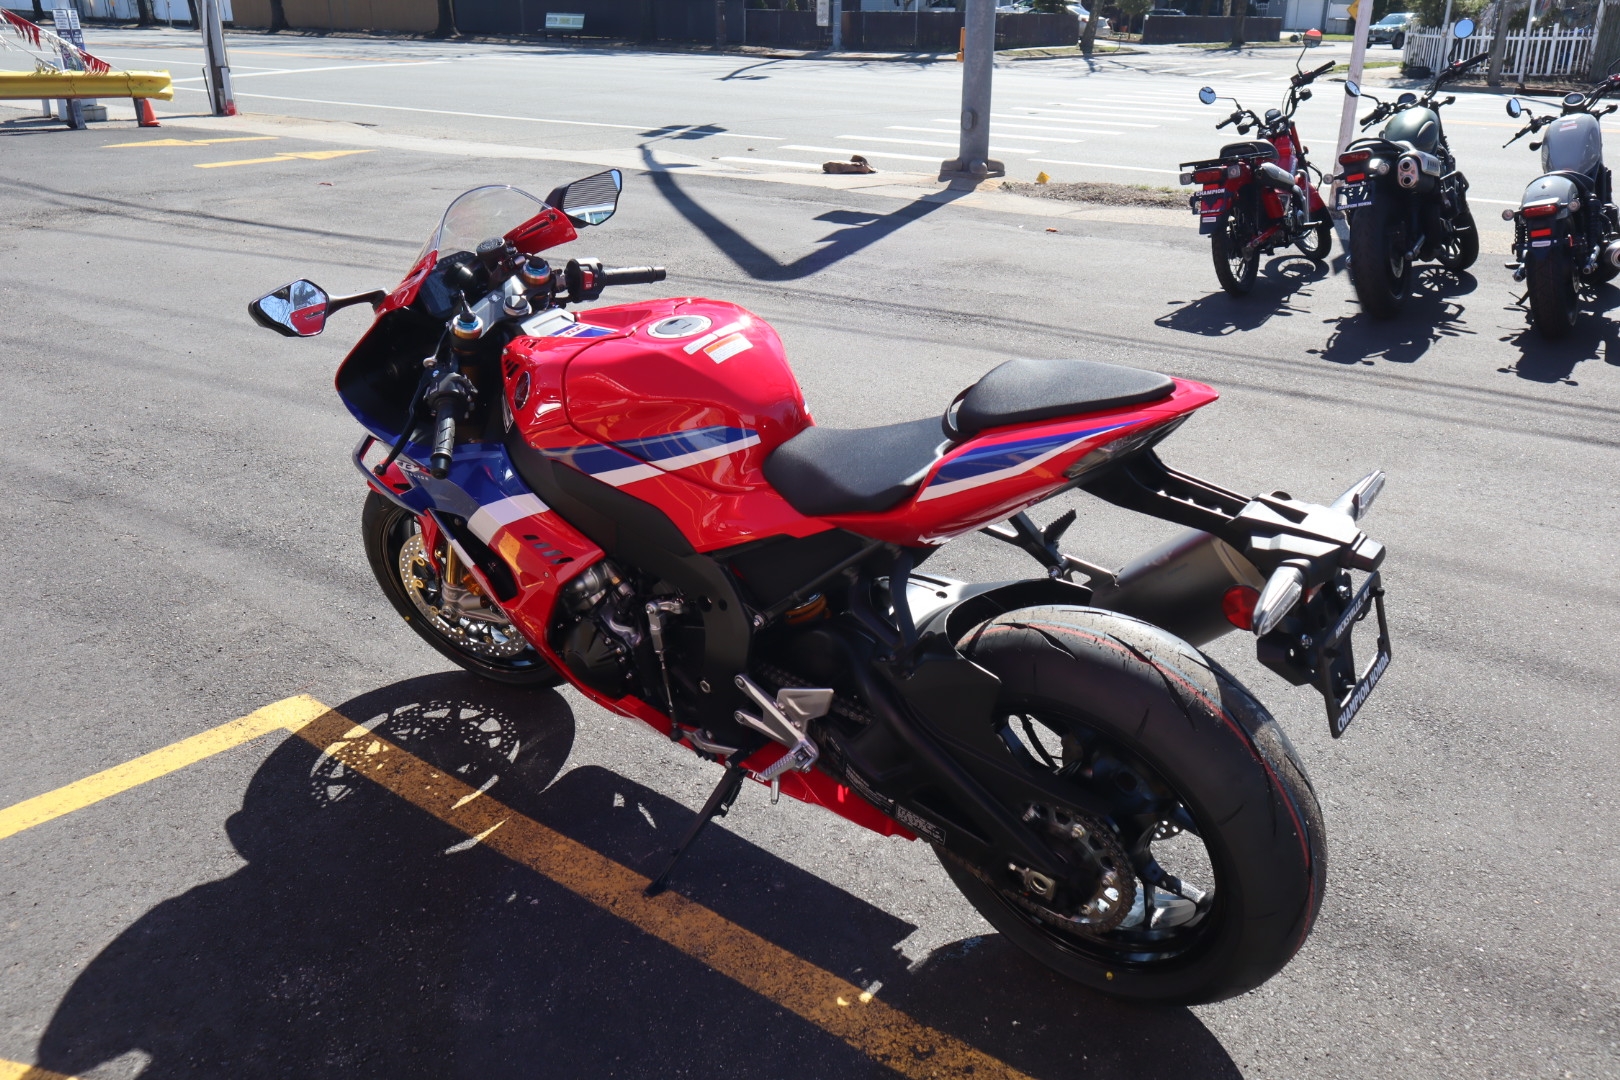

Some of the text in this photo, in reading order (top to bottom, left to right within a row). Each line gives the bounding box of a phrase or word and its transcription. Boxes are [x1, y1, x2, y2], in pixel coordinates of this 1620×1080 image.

[1195, 187, 1225, 197] CHAMPION
[1338, 651, 1389, 732] CHAMPION HONDA
